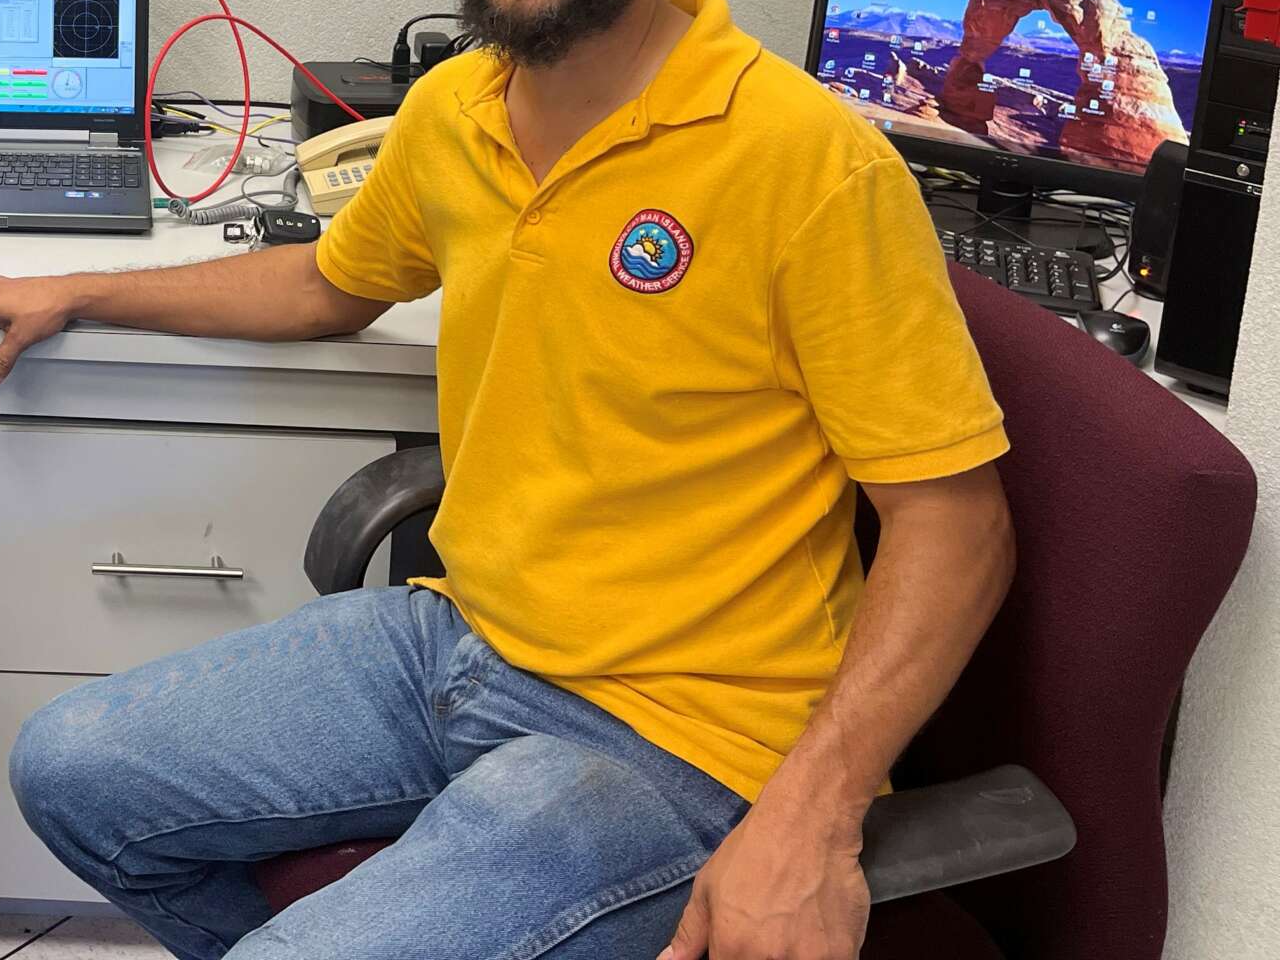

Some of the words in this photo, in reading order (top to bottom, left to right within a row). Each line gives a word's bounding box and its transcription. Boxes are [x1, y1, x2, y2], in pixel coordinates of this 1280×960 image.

[661, 216, 690, 256] ISLANDS
[617, 269, 662, 291] WEATHER
[662, 256, 690, 288] SERVICE
